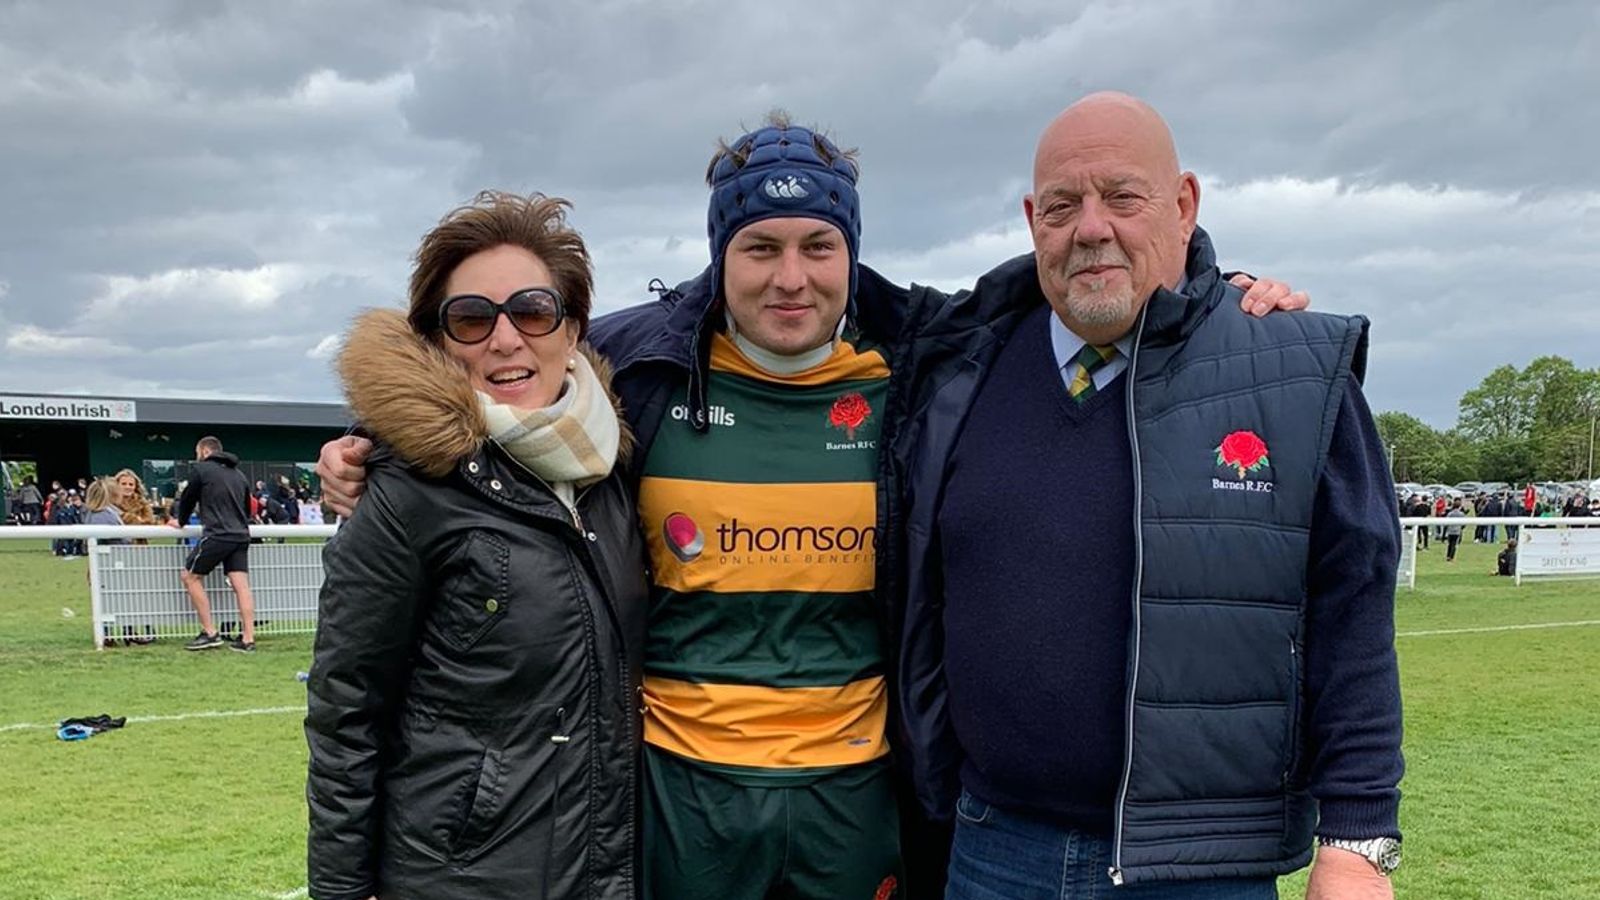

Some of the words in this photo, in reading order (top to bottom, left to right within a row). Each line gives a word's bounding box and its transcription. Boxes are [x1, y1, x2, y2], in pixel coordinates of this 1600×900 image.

[0, 401, 68, 416] London
[71, 403, 110, 417] Irish
[826, 442, 857, 450] Barnes
[1212, 478, 1245, 490] Barnes
[716, 518, 876, 553] thomson
[719, 555, 791, 565] ONLINE
